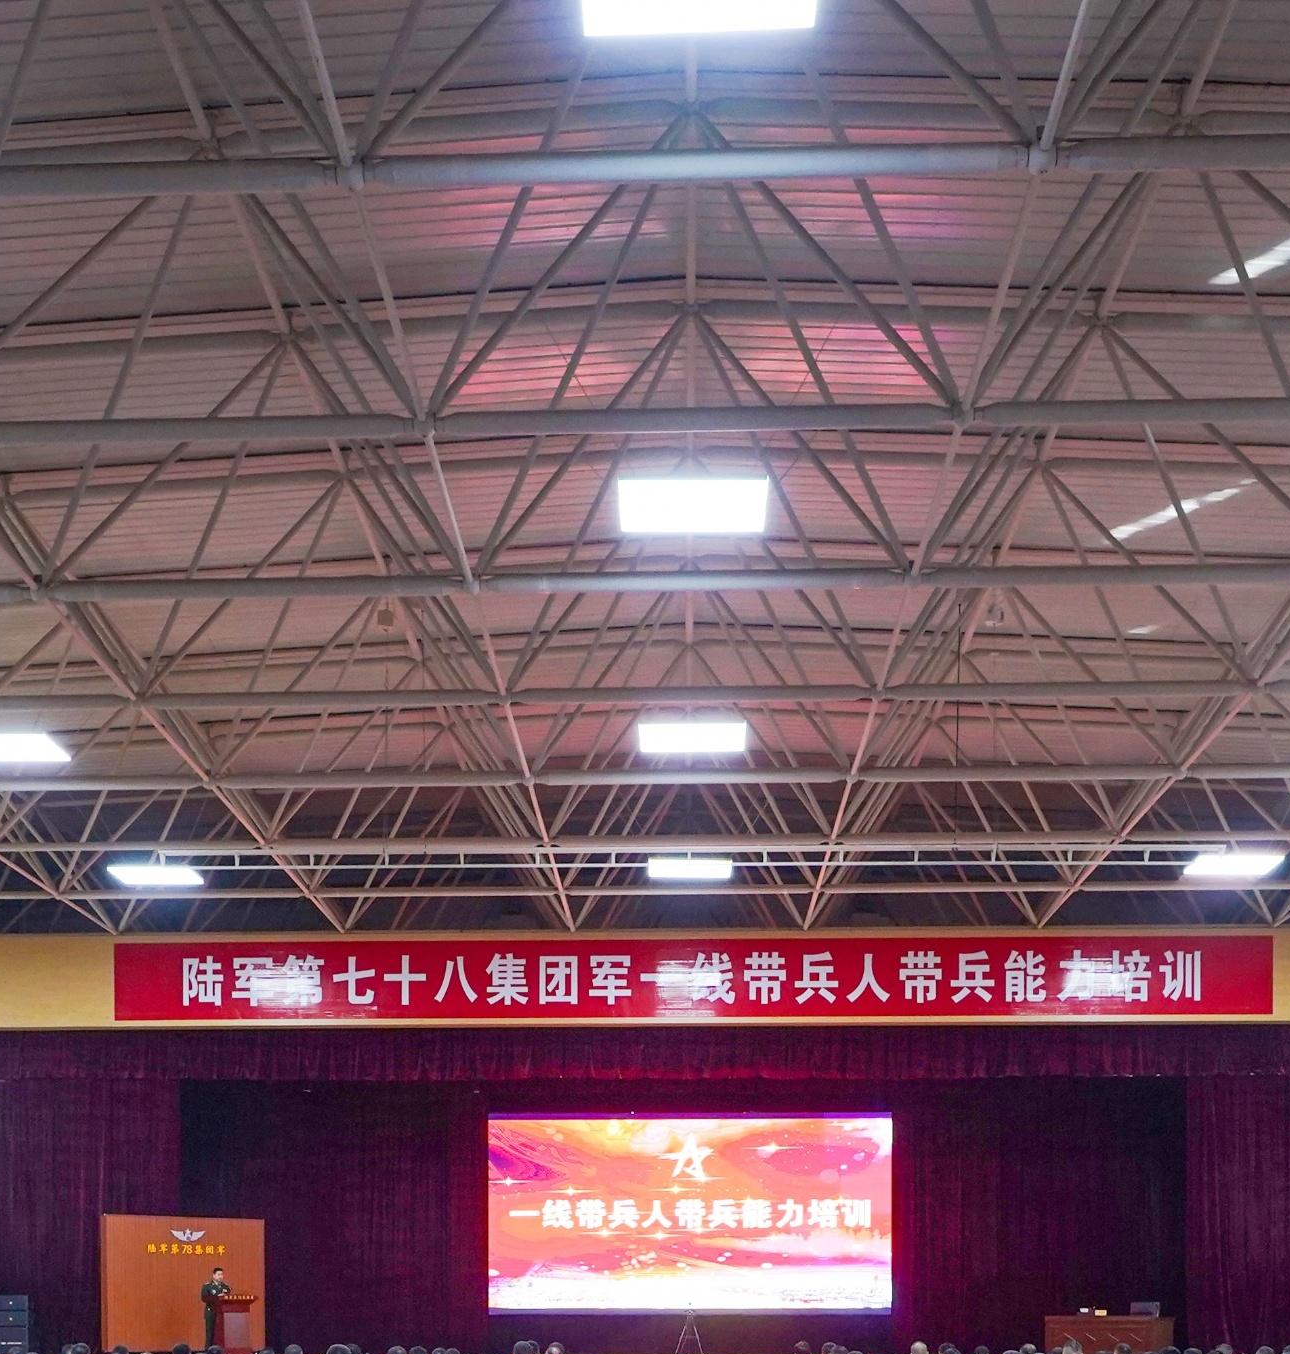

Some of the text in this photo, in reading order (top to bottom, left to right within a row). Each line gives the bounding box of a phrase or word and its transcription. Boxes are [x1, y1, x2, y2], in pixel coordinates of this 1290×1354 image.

[181, 950, 1203, 1007] 陆军第七十八集团军一线带兵人带兵能力培训
[509, 1198, 872, 1229] 一线带兵人带兵能力培训
